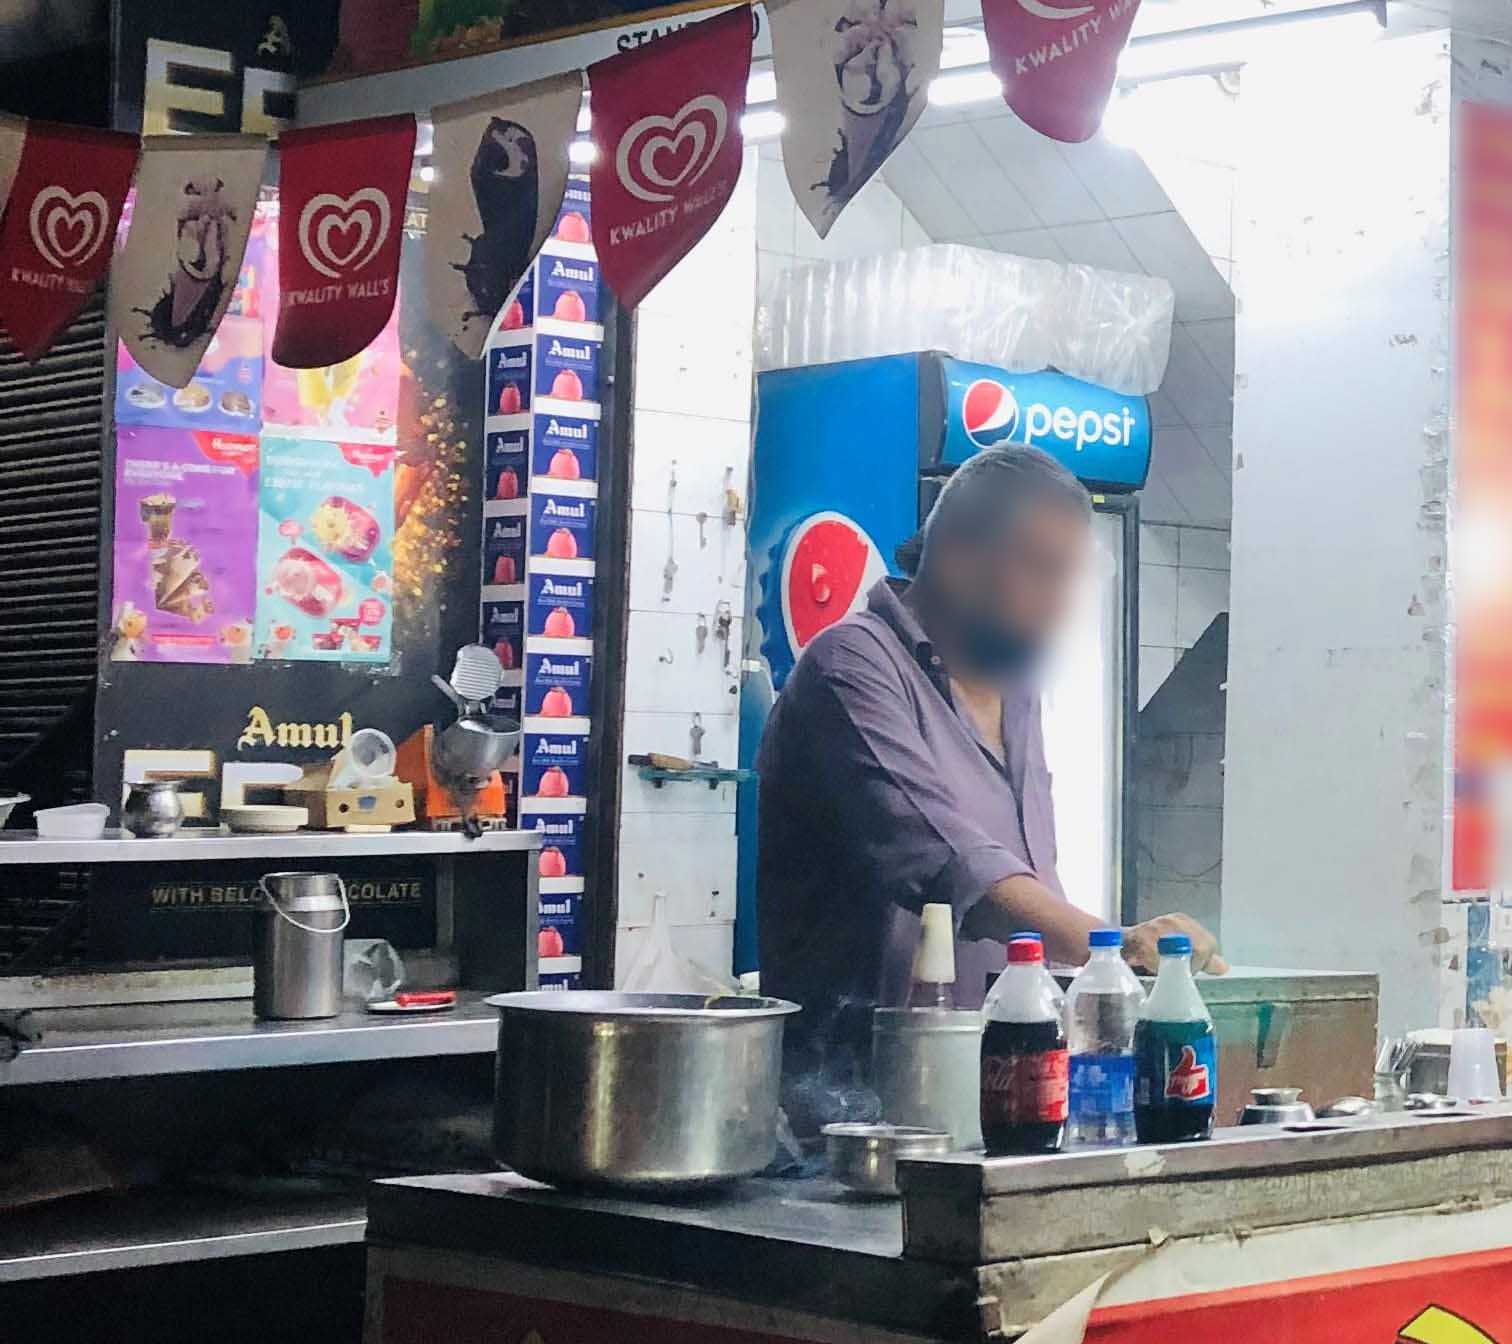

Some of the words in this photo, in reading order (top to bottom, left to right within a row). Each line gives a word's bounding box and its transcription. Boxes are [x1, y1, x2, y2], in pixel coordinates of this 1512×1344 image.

[1015, 15, 1102, 76] KWALITY
[610, 205, 679, 246] KWALITY
[552, 260, 594, 282] Amul
[347, 278, 390, 299] WALL'S
[549, 339, 591, 361] Amul
[547, 419, 588, 440] Amul
[1025, 398, 1135, 450] pepsi
[543, 498, 585, 518] Amul
[541, 578, 583, 598] Amul
[539, 657, 580, 677] Amul
[238, 706, 352, 751] Amul
[535, 737, 577, 757] Amul
[152, 887, 203, 905] WITH
[347, 882, 422, 901] COLATE
